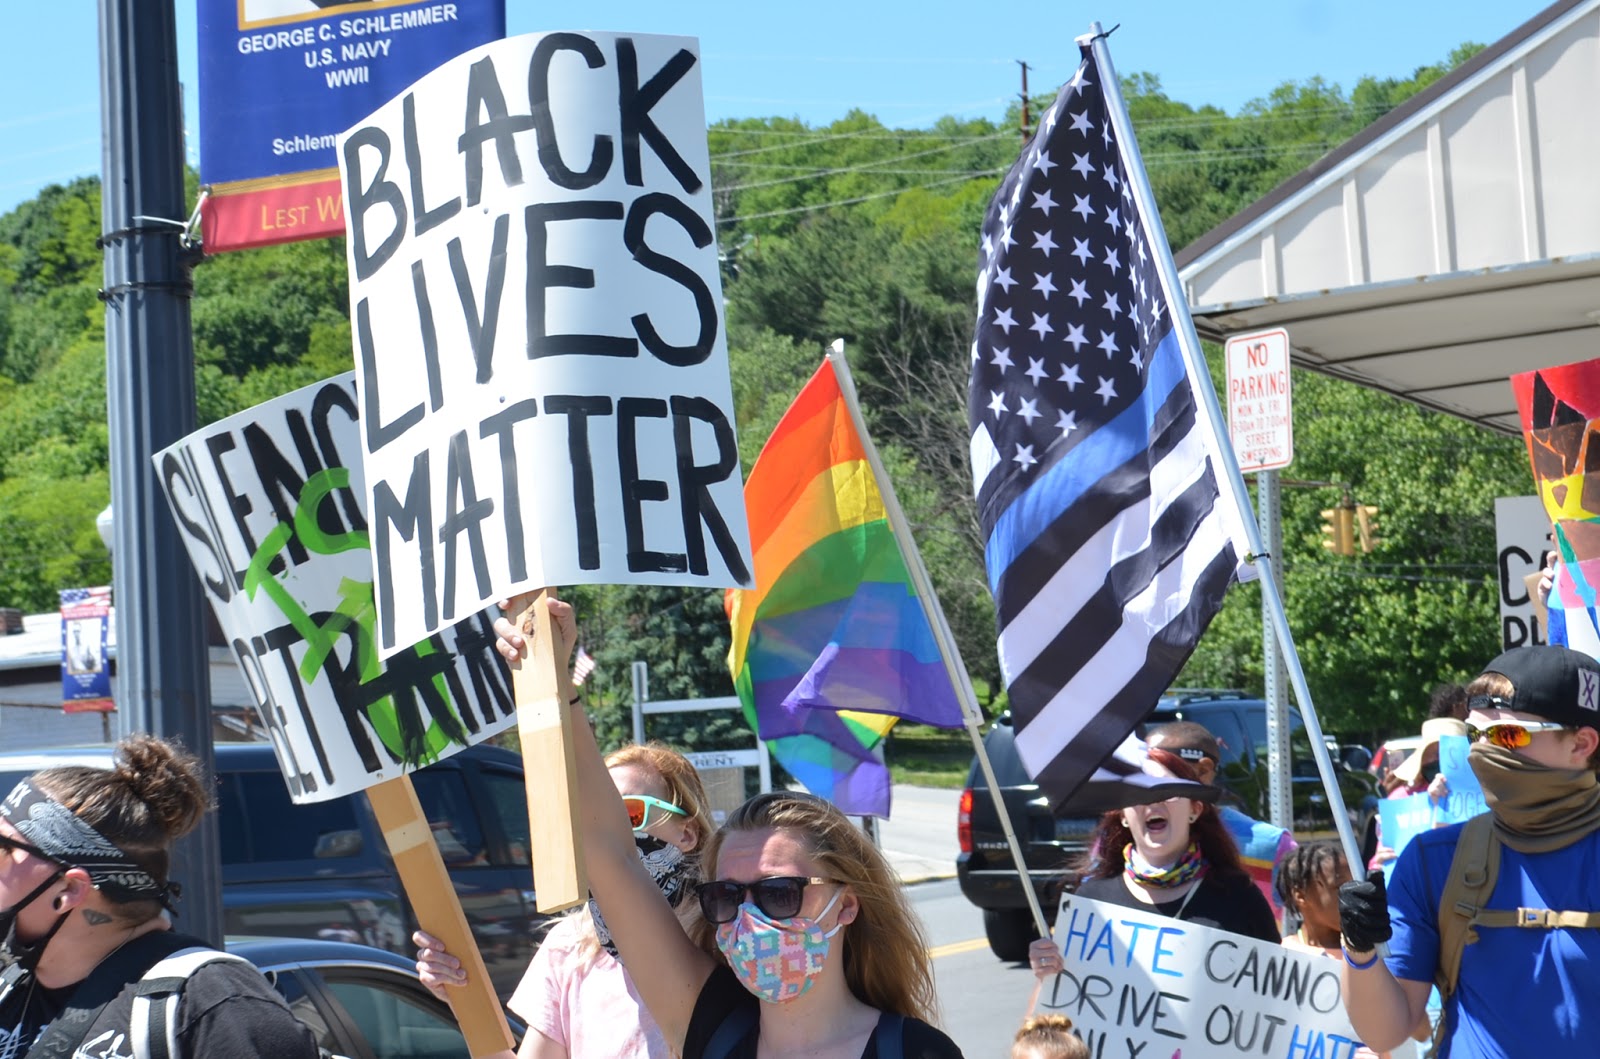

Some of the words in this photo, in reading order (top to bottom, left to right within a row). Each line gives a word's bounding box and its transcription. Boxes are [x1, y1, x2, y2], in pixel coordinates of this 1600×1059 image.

[237, 27, 315, 54] GEORGE
[318, 23, 337, 41] C.
[340, 4, 458, 37] SCHLEMMER
[304, 47, 338, 68] U.S.
[341, 38, 392, 62] NAVY
[325, 66, 370, 89] WWII
[343, 32, 702, 282] BLACK
[357, 192, 718, 454] LIVES
[1246, 342, 1269, 369] NO
[1232, 370, 1286, 402] PARKING
[1240, 445, 1283, 463] SWEEPING
[1245, 431, 1276, 447] STREET
[162, 380, 370, 604] SILENC
[373, 396, 752, 650] MATTER
[694, 757, 736, 768] RENT
[1040, 969, 1191, 1041] DRIVE
[1206, 1004, 1287, 1055] OUT
